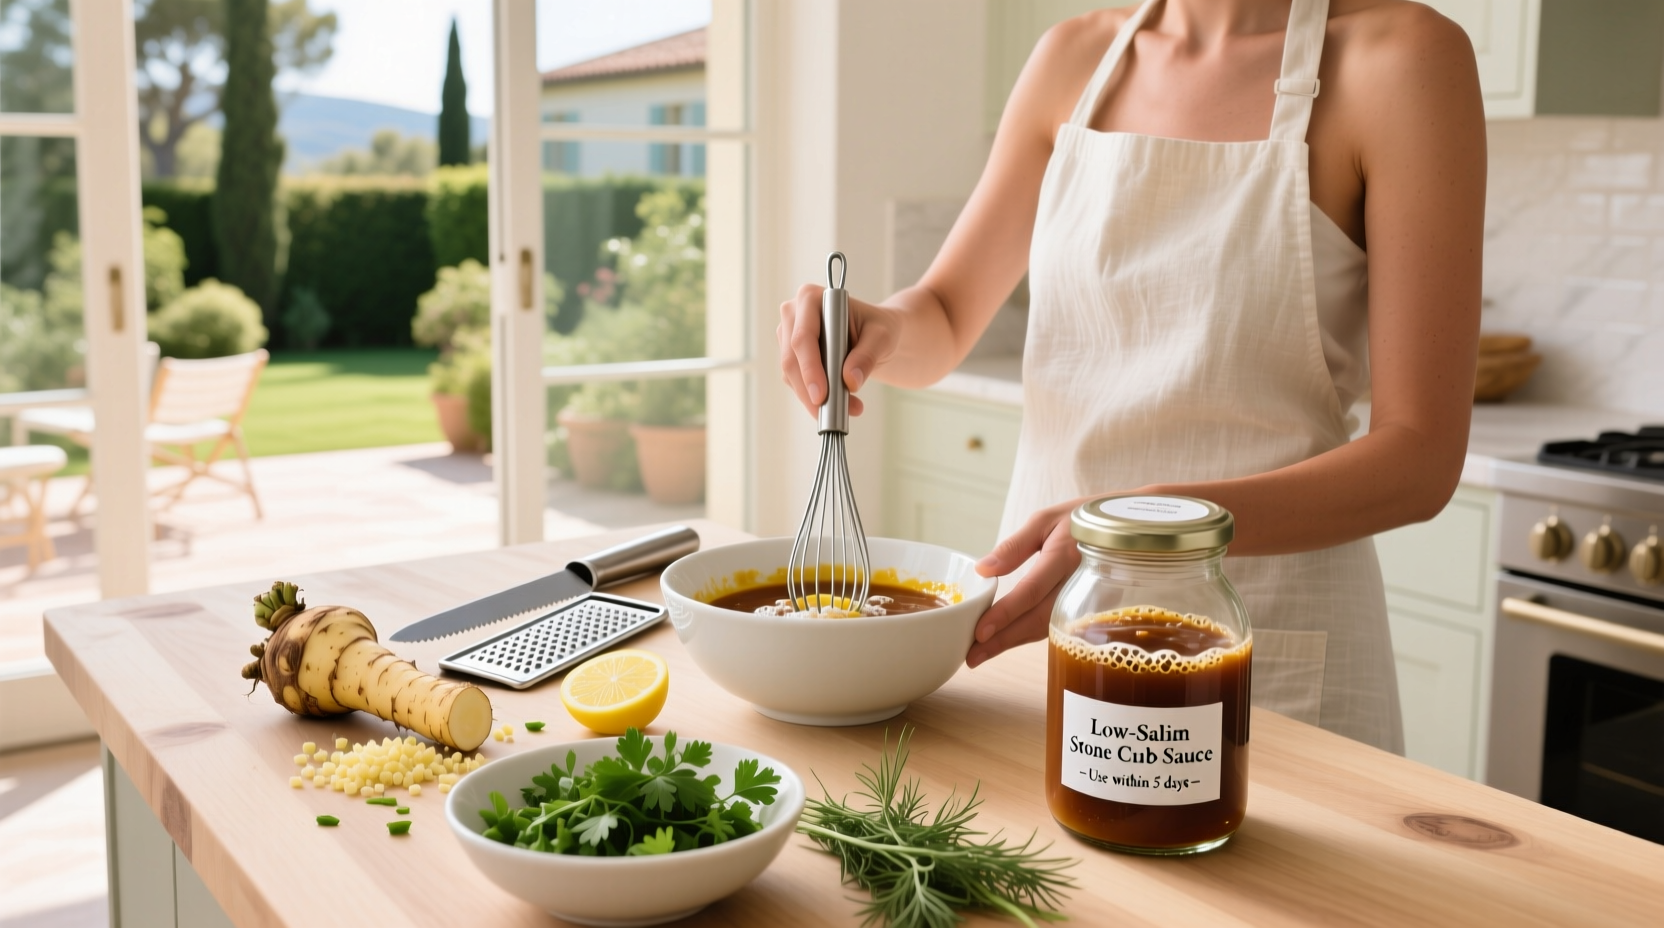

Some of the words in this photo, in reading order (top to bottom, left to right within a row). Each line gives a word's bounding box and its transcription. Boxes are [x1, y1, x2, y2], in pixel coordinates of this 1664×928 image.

[1091, 718, 1190, 742] Low-Salim
[1118, 745, 1158, 764] Cub
[1162, 747, 1213, 764] Sauce
[1112, 773, 1150, 788] within
[1153, 776, 1161, 789] 5
